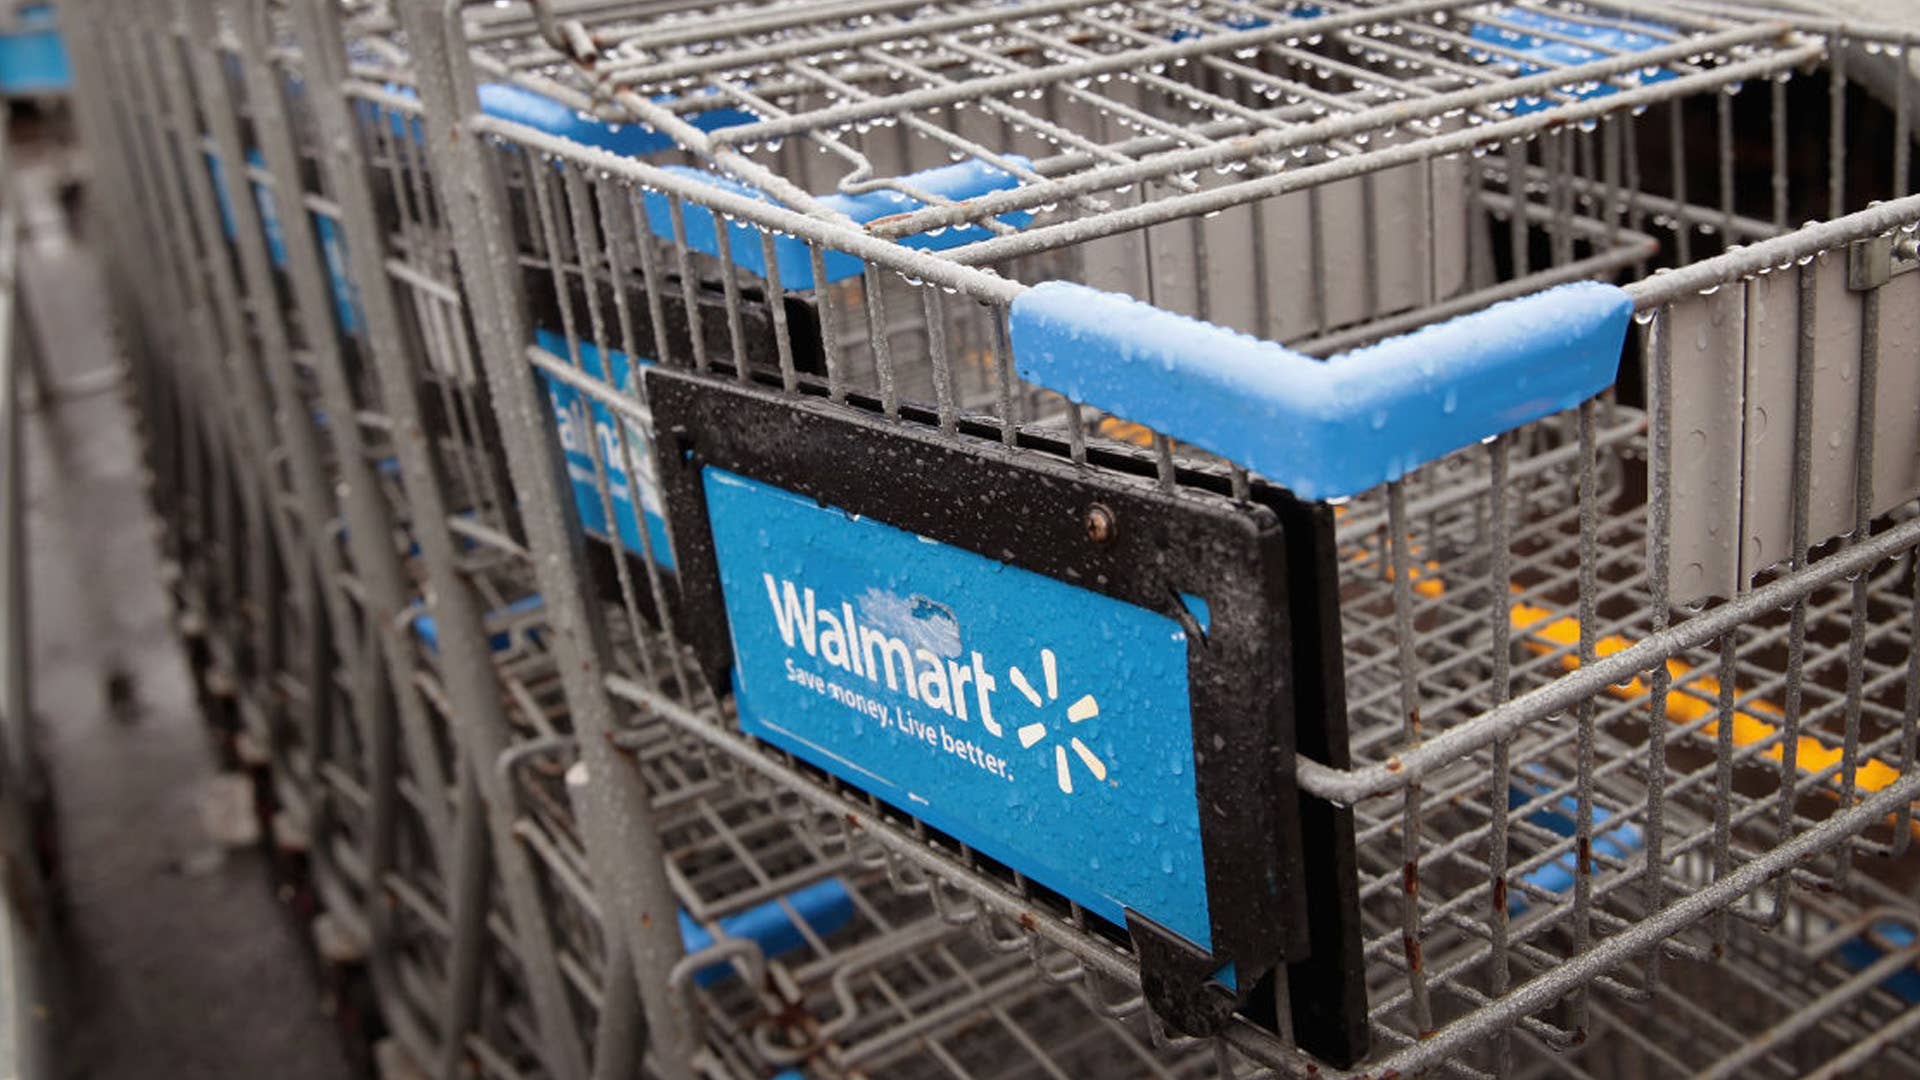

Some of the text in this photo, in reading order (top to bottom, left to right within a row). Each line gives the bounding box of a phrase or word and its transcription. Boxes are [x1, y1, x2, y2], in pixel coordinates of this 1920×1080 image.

[762, 572, 1003, 738] Walmart
[785, 657, 1014, 782] Save money. Live better.
